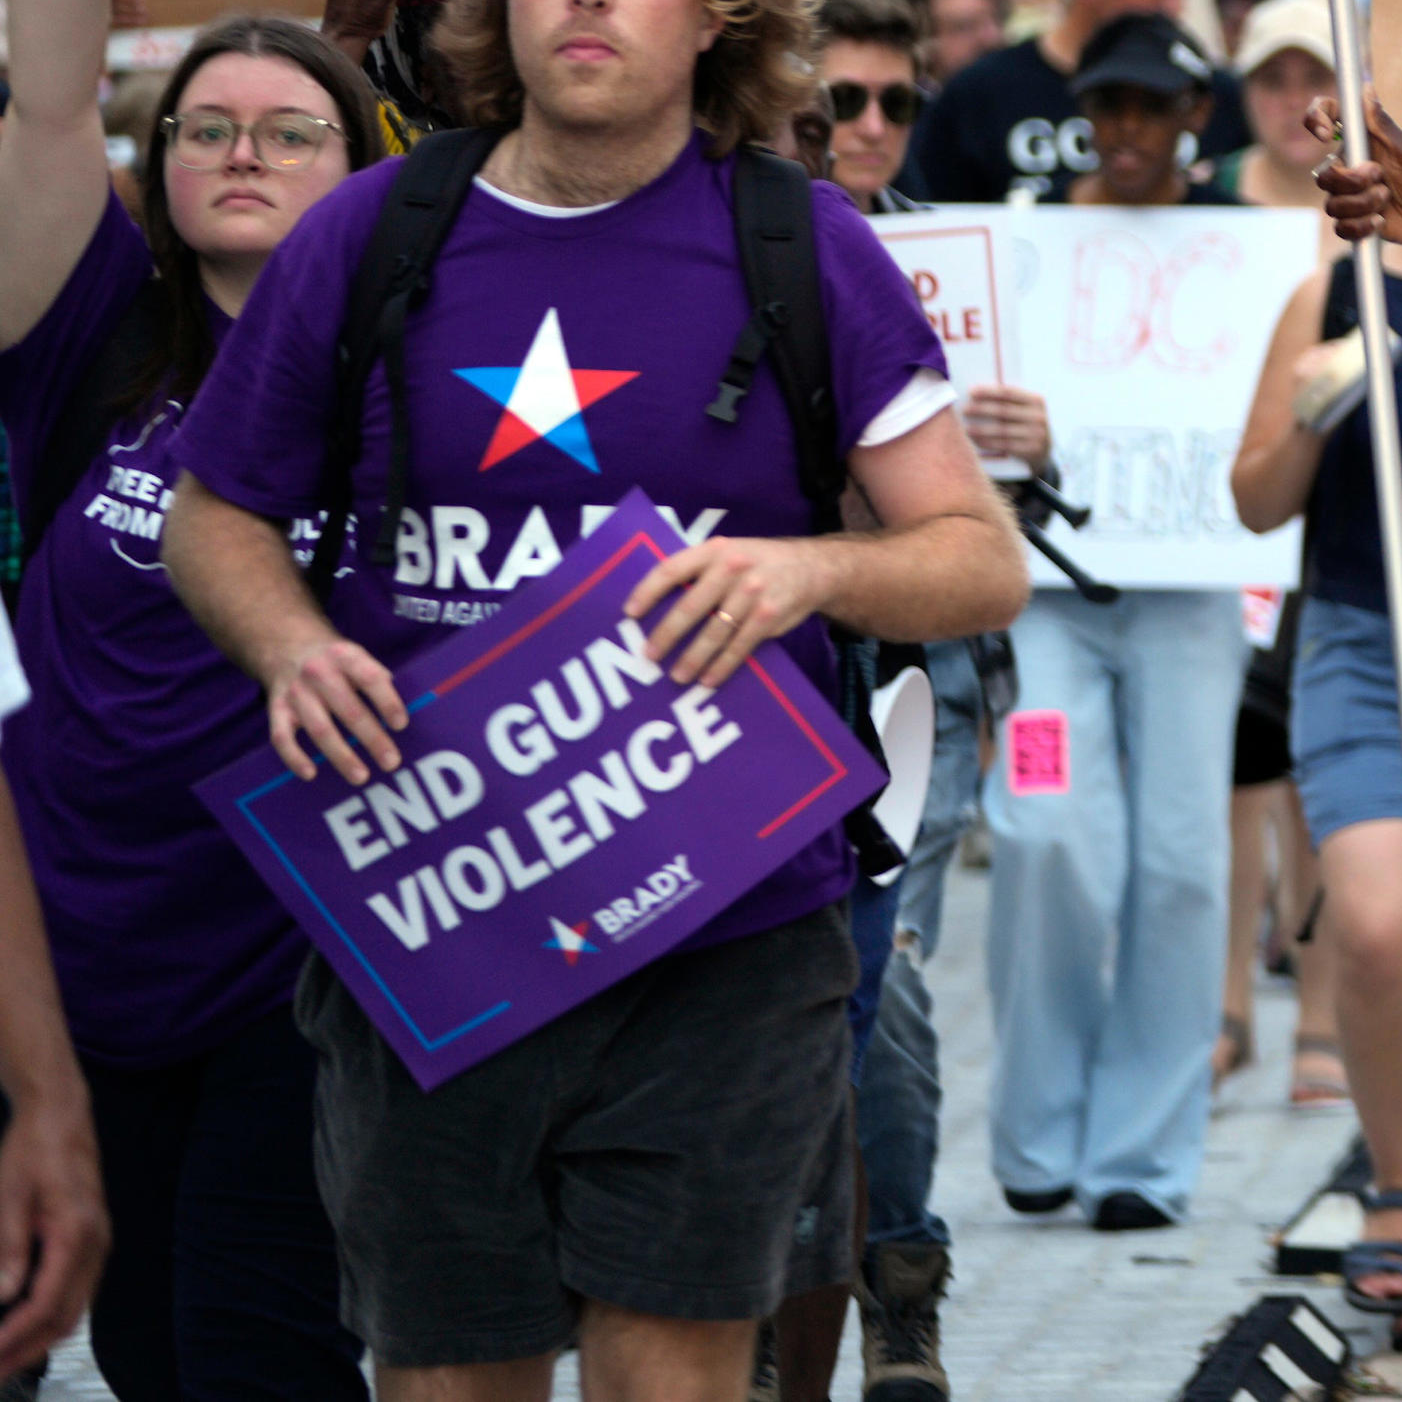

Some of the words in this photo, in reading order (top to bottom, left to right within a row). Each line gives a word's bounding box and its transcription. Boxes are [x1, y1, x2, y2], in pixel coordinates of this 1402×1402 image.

[83, 493, 164, 541] FROM
[320, 750, 486, 873] END
[484, 618, 666, 777] GUN
[366, 686, 742, 953] VIOLENCE
[592, 853, 694, 935] BRADY
